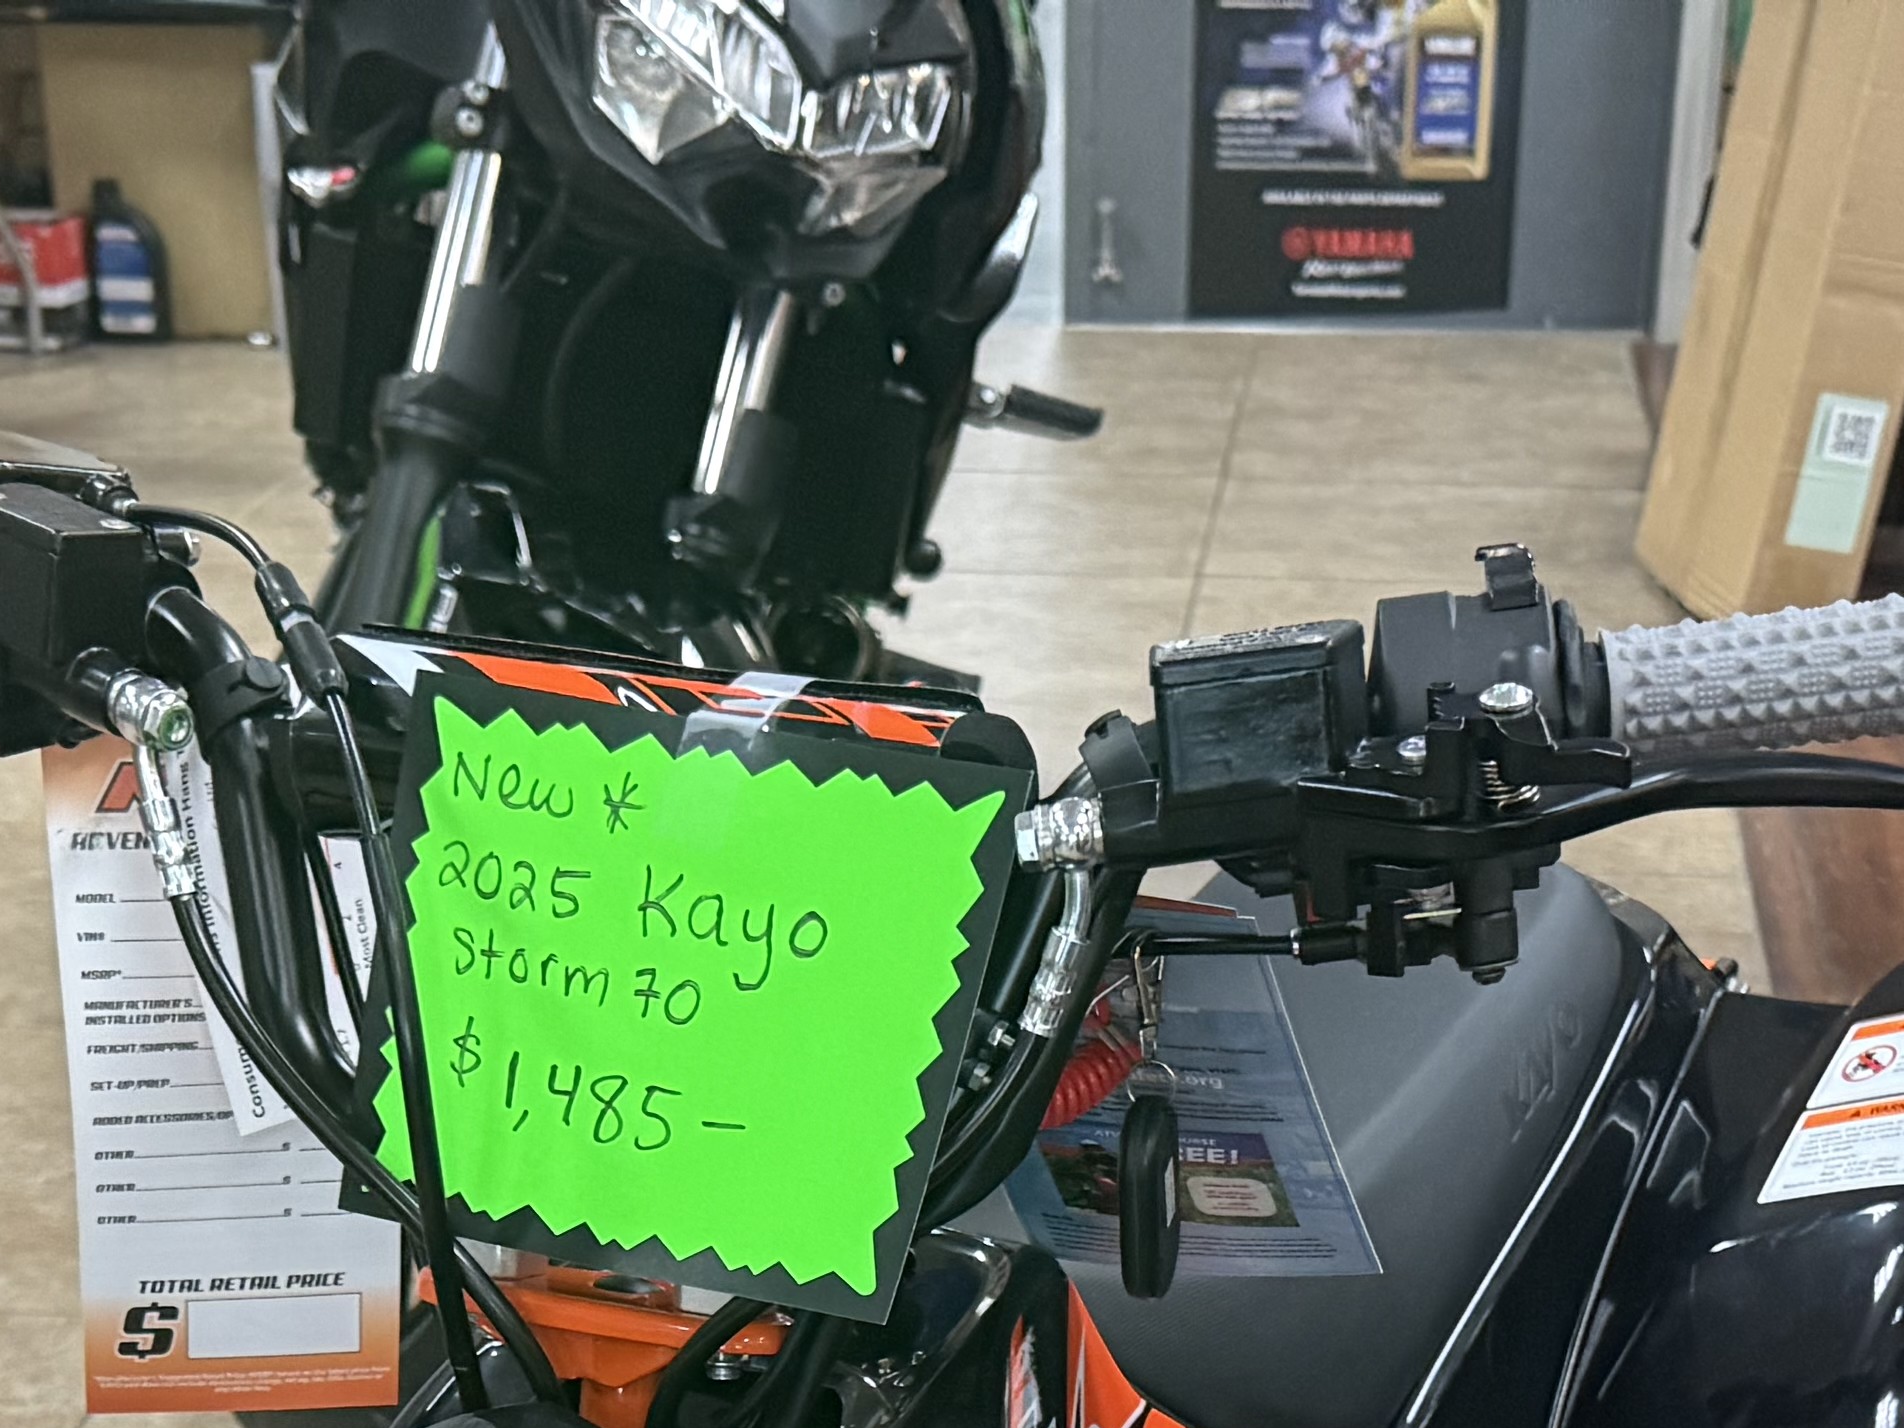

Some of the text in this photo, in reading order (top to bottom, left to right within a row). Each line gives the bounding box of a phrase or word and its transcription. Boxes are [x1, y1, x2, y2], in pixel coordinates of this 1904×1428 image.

[453, 752, 574, 818] New
[75, 893, 116, 904] MODEL
[438, 840, 828, 992] 2025 Kayo
[453, 927, 701, 1025] Storm 70
[237, 1043, 265, 1119] Consum
[139, 1272, 346, 1294] TOTAL RETAIL PRICE
[117, 1301, 180, 1360] $
